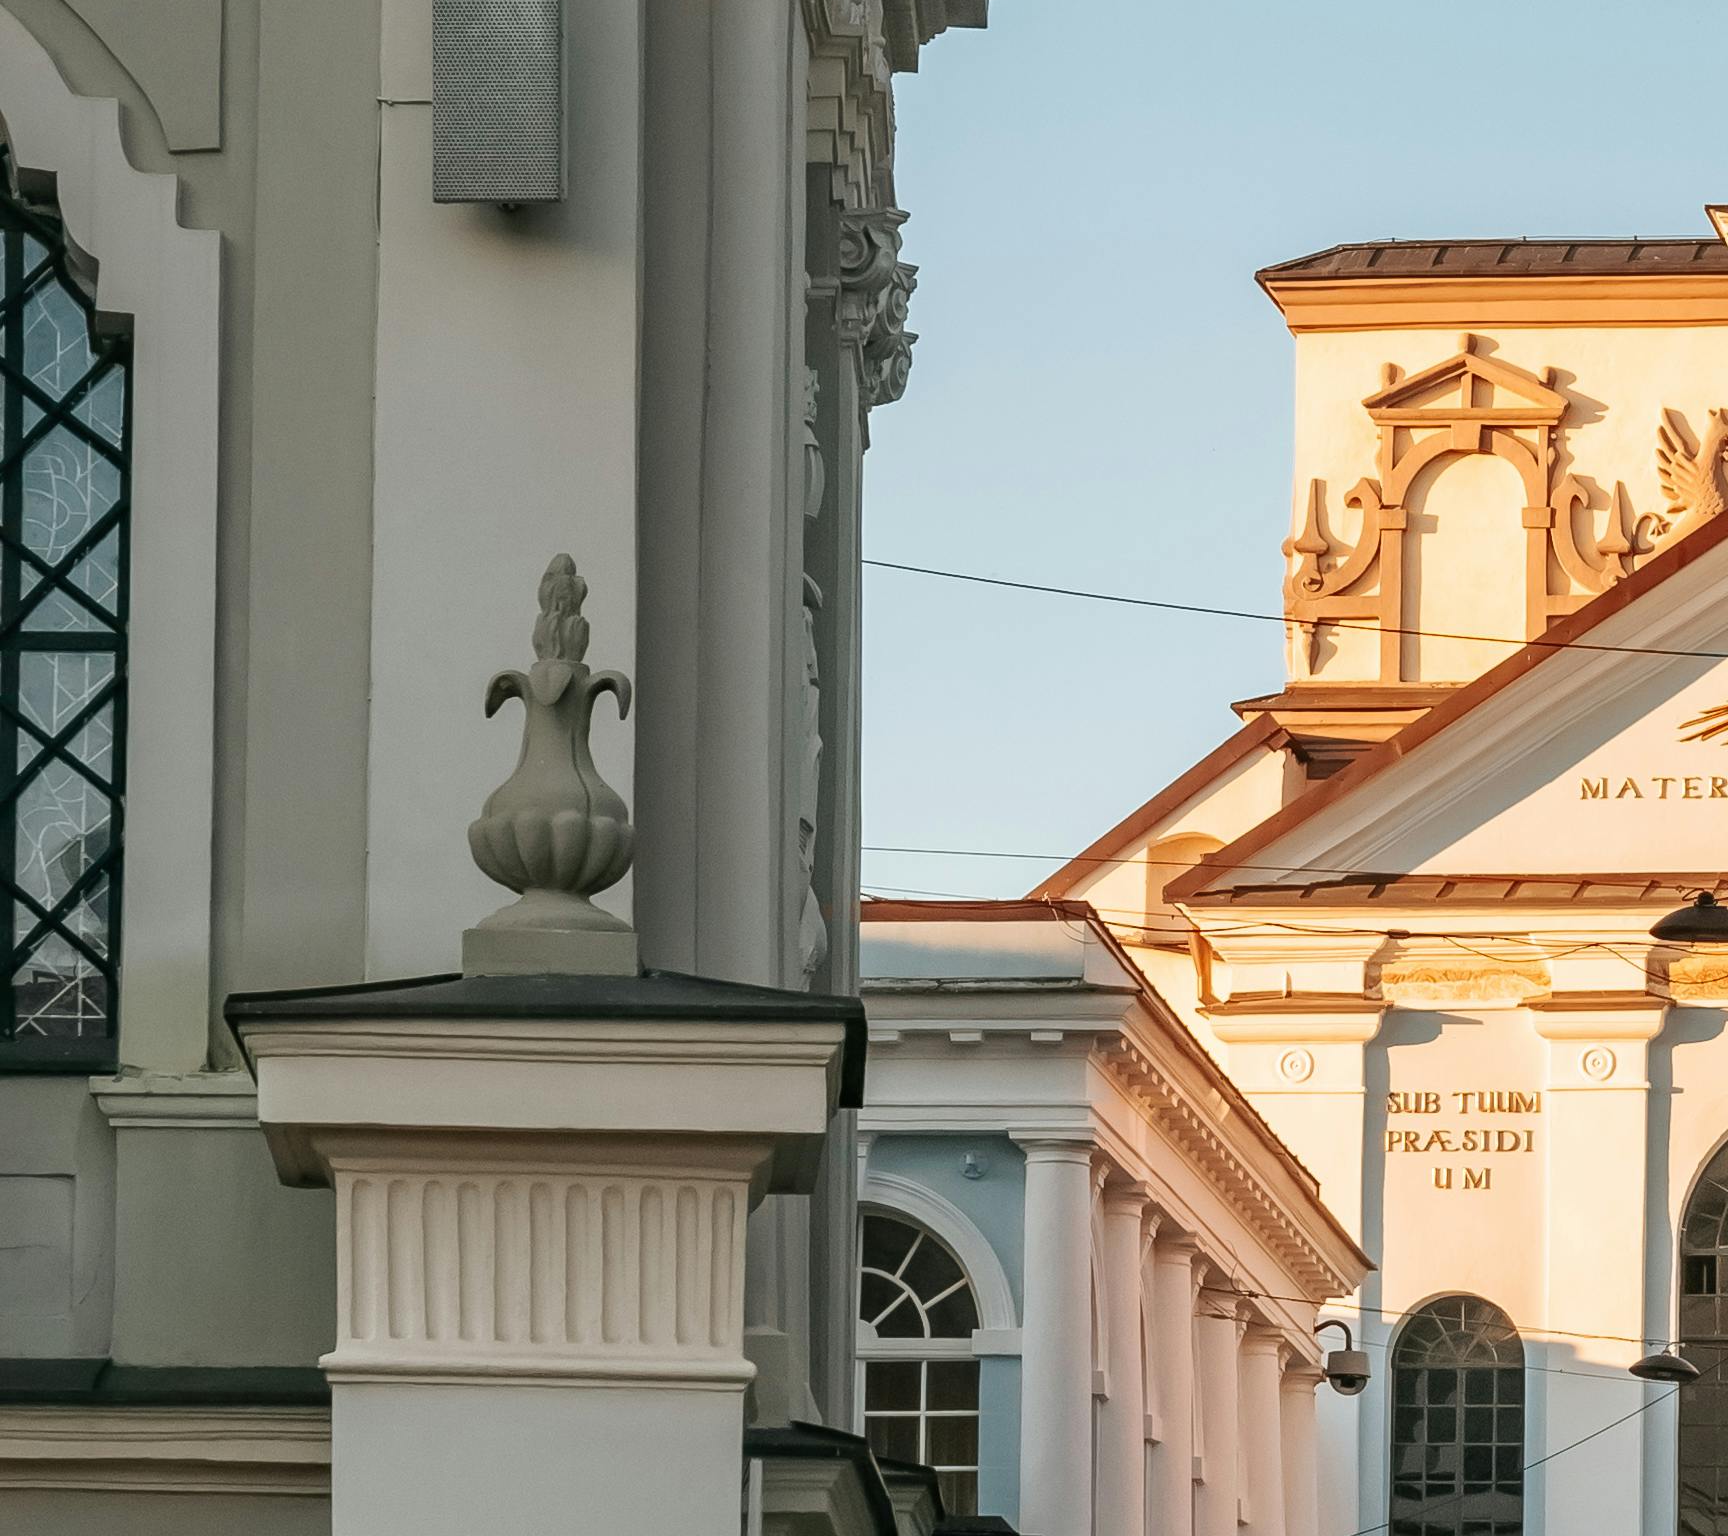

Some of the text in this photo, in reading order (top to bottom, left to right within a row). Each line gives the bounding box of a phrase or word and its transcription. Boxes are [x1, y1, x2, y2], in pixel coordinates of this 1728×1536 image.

[1386, 1091, 1542, 1114] SUB TUUM
[1385, 1130, 1535, 1152] PRÆSIDI
